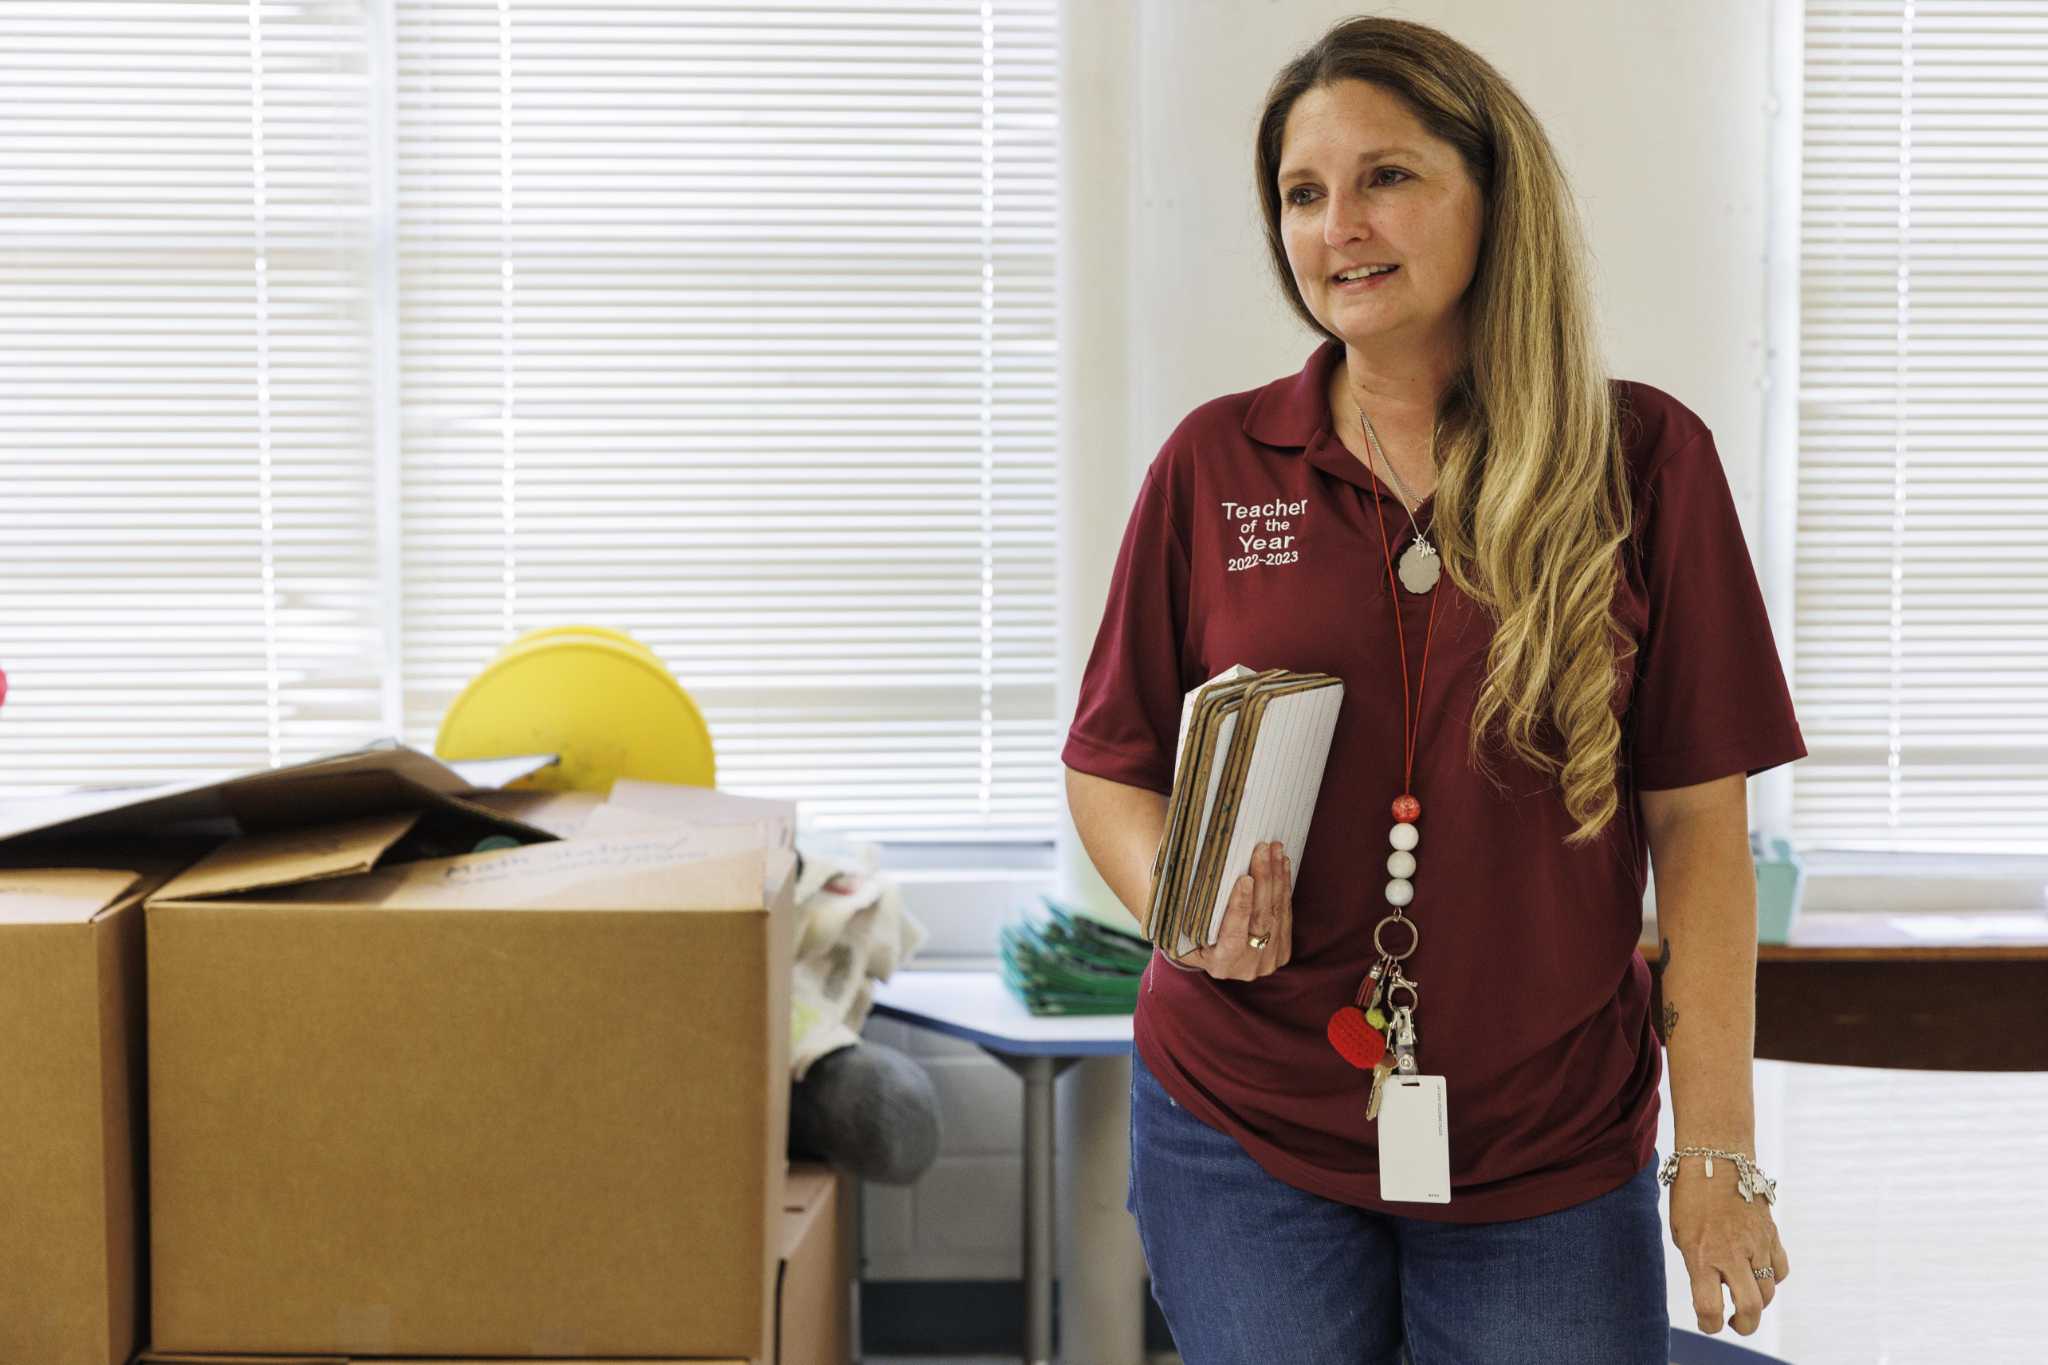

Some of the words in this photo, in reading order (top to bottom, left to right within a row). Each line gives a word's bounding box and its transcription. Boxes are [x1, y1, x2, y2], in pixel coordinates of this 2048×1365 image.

[1221, 498, 1308, 520] Teacher
[1240, 519, 1258, 534] of
[1265, 518, 1290, 532] the
[1238, 534, 1295, 553] Year
[1228, 550, 1299, 571] 2022-2023
